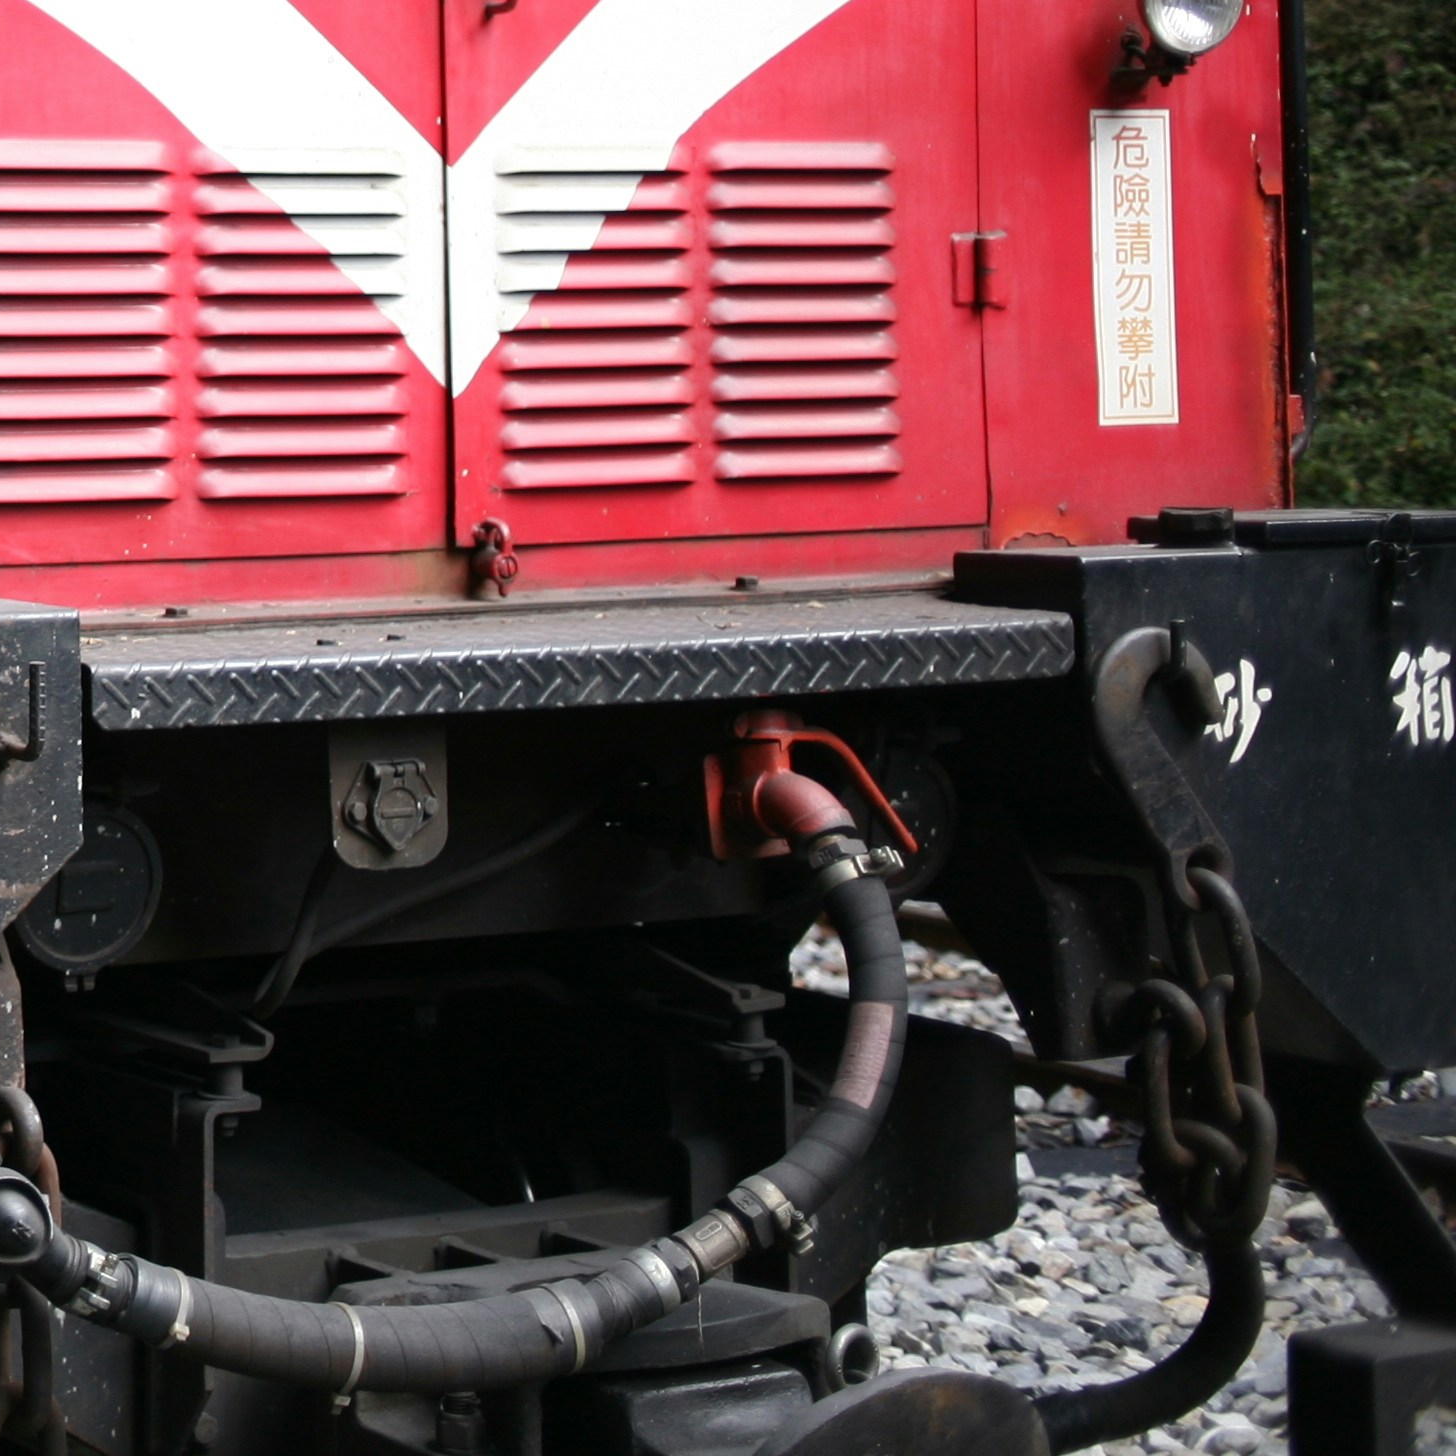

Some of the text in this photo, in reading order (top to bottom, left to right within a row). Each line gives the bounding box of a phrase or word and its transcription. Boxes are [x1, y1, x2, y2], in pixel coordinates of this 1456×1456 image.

[1111, 124, 1156, 410] 危險請勿攀附
